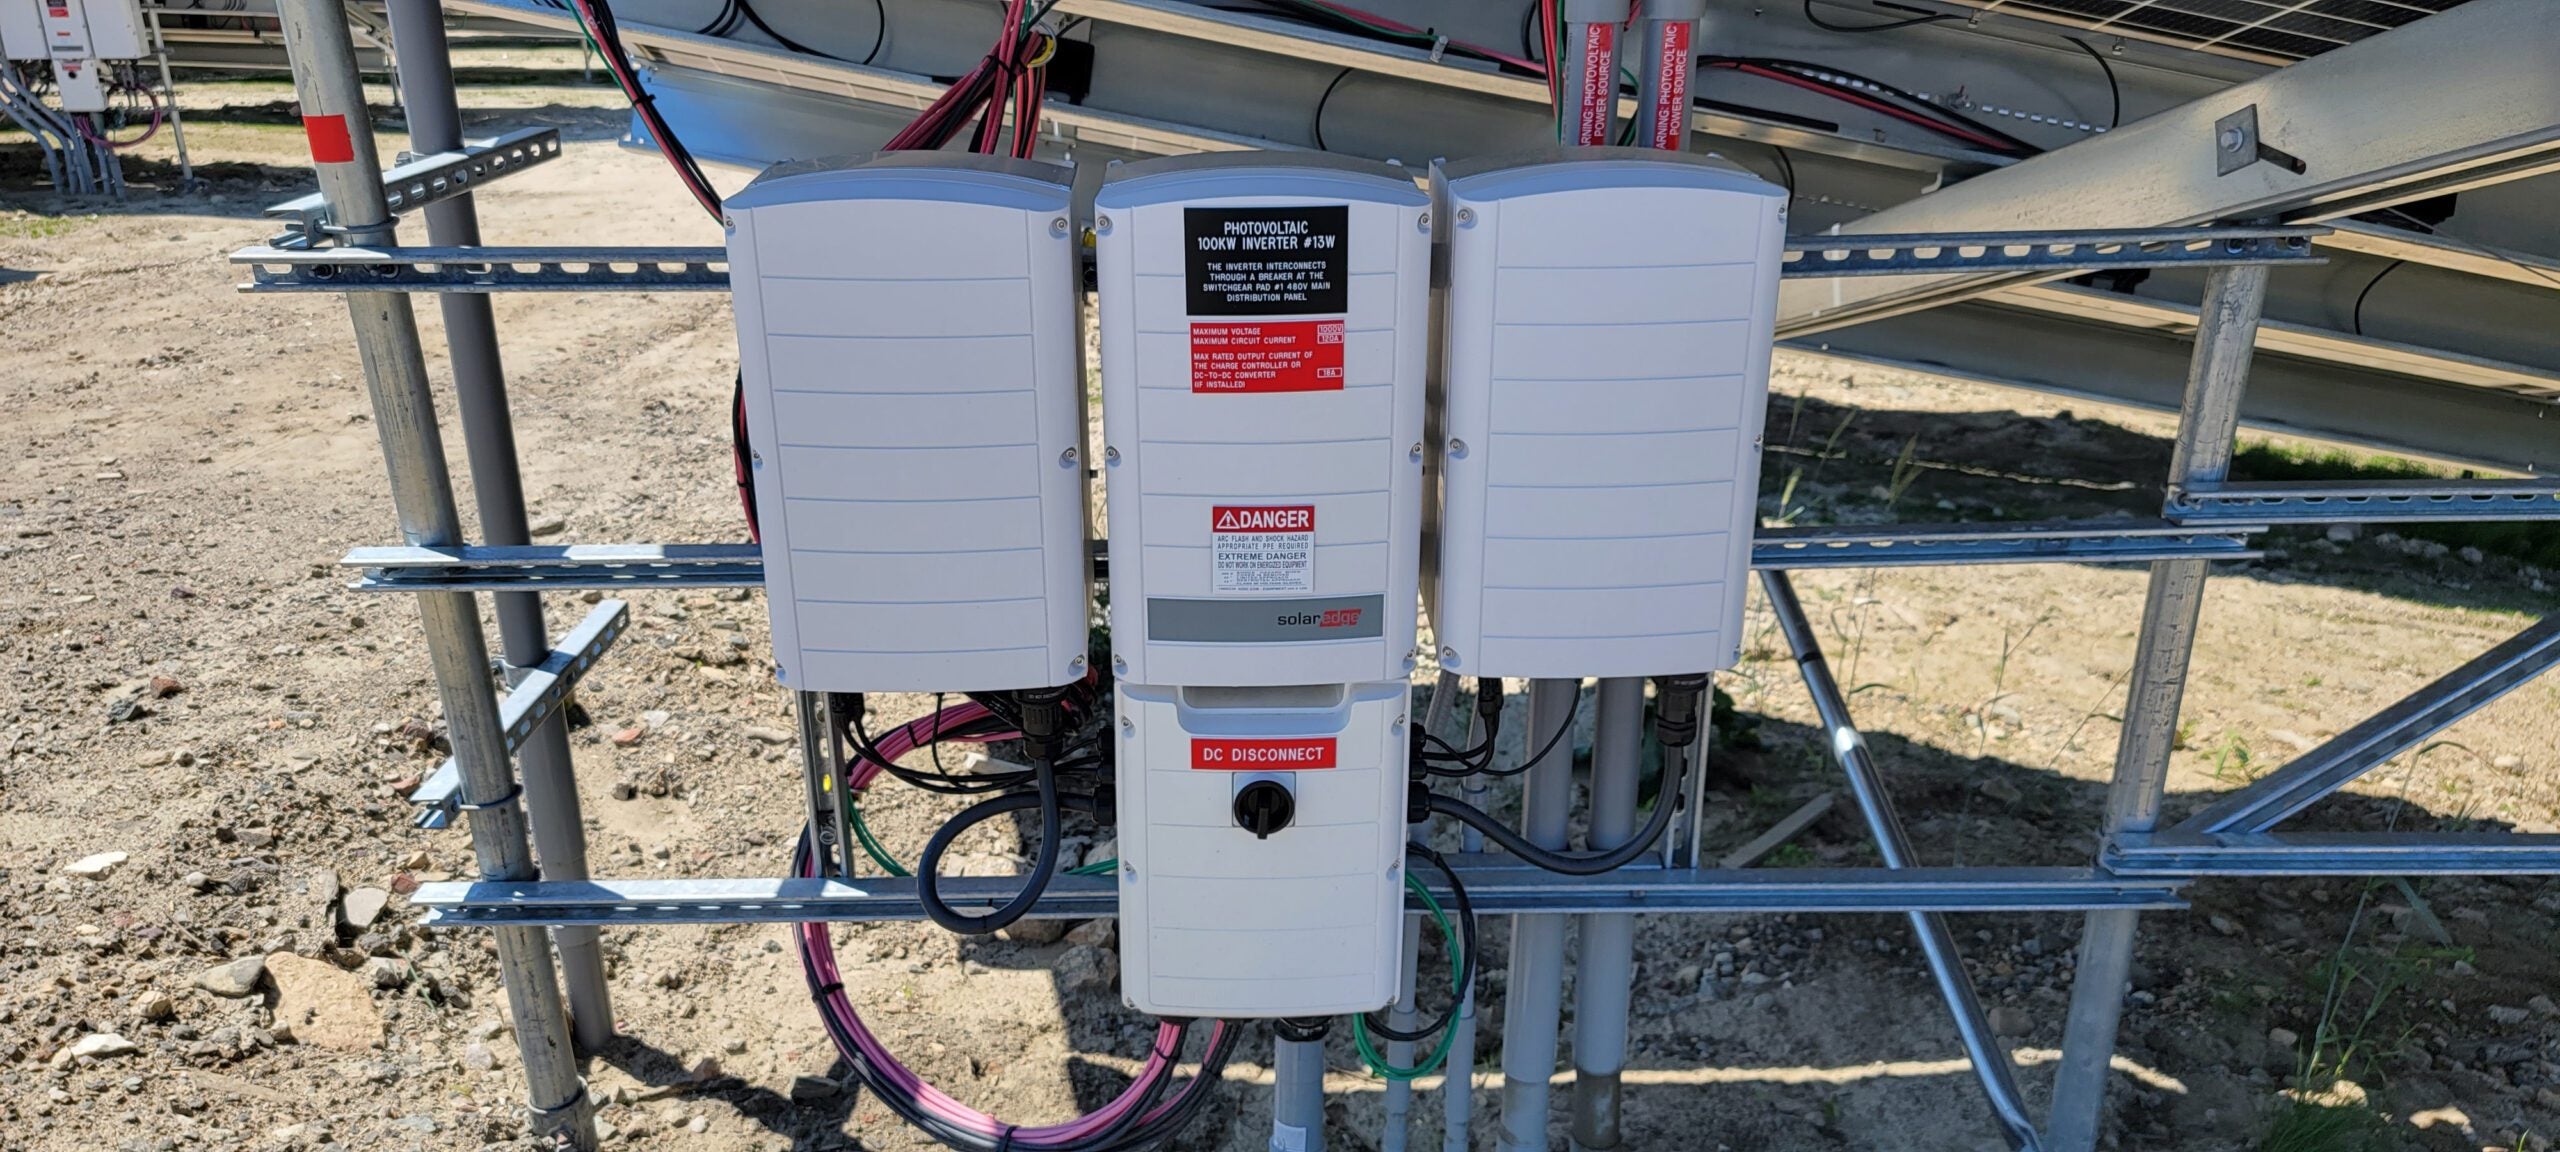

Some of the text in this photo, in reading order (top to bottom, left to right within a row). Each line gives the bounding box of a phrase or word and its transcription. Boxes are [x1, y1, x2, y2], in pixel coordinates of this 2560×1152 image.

[1581, 25, 1601, 147] RNING: PHOTOVOLTAIC
[1656, 24, 1677, 149] ARNING: PHOTOVOLTAIC
[1594, 50, 1611, 137] POWER SOURCE
[1670, 49, 1687, 136] POWER SOURCE
[1224, 220, 1309, 235] PHOTOVOLTAIC
[1198, 235, 1335, 250] 100KW INVERTER #13W
[1207, 261, 1327, 271] THE INVERTER INTERCONNECTS
[1210, 271, 1324, 281] THROUGH A BREAKER AT THE
[1203, 282, 1331, 292] SWITCHGEAR PAD #1 480V MAIN
[1227, 292, 1307, 302] DISTRIBUTION PANEL
[1193, 327, 1261, 335] MAXIMUM VOLTAGE
[1193, 336, 1296, 345] MAXIMUM CIRCUIT CURRENT
[1212, 352, 1234, 360] RATED
[1237, 352, 1265, 360] OUTPUT
[1268, 351, 1301, 359] CURRENT
[1304, 351, 1313, 359] OF
[1194, 362, 1207, 370] THE
[1211, 362, 1239, 370] CHARGE
[1242, 361, 1288, 369] CONTROLLER
[1194, 371, 1276, 379] DC-TO-DC CONVERTER
[1240, 510, 1309, 528] DANGER
[1286, 534, 1309, 542] HAZARD
[1217, 542, 1309, 550] APPROPRIATE PPE REQUIRED
[1218, 552, 1307, 561] EXTREME DANGER
[1203, 746, 1324, 762] DC DISCONNECT
